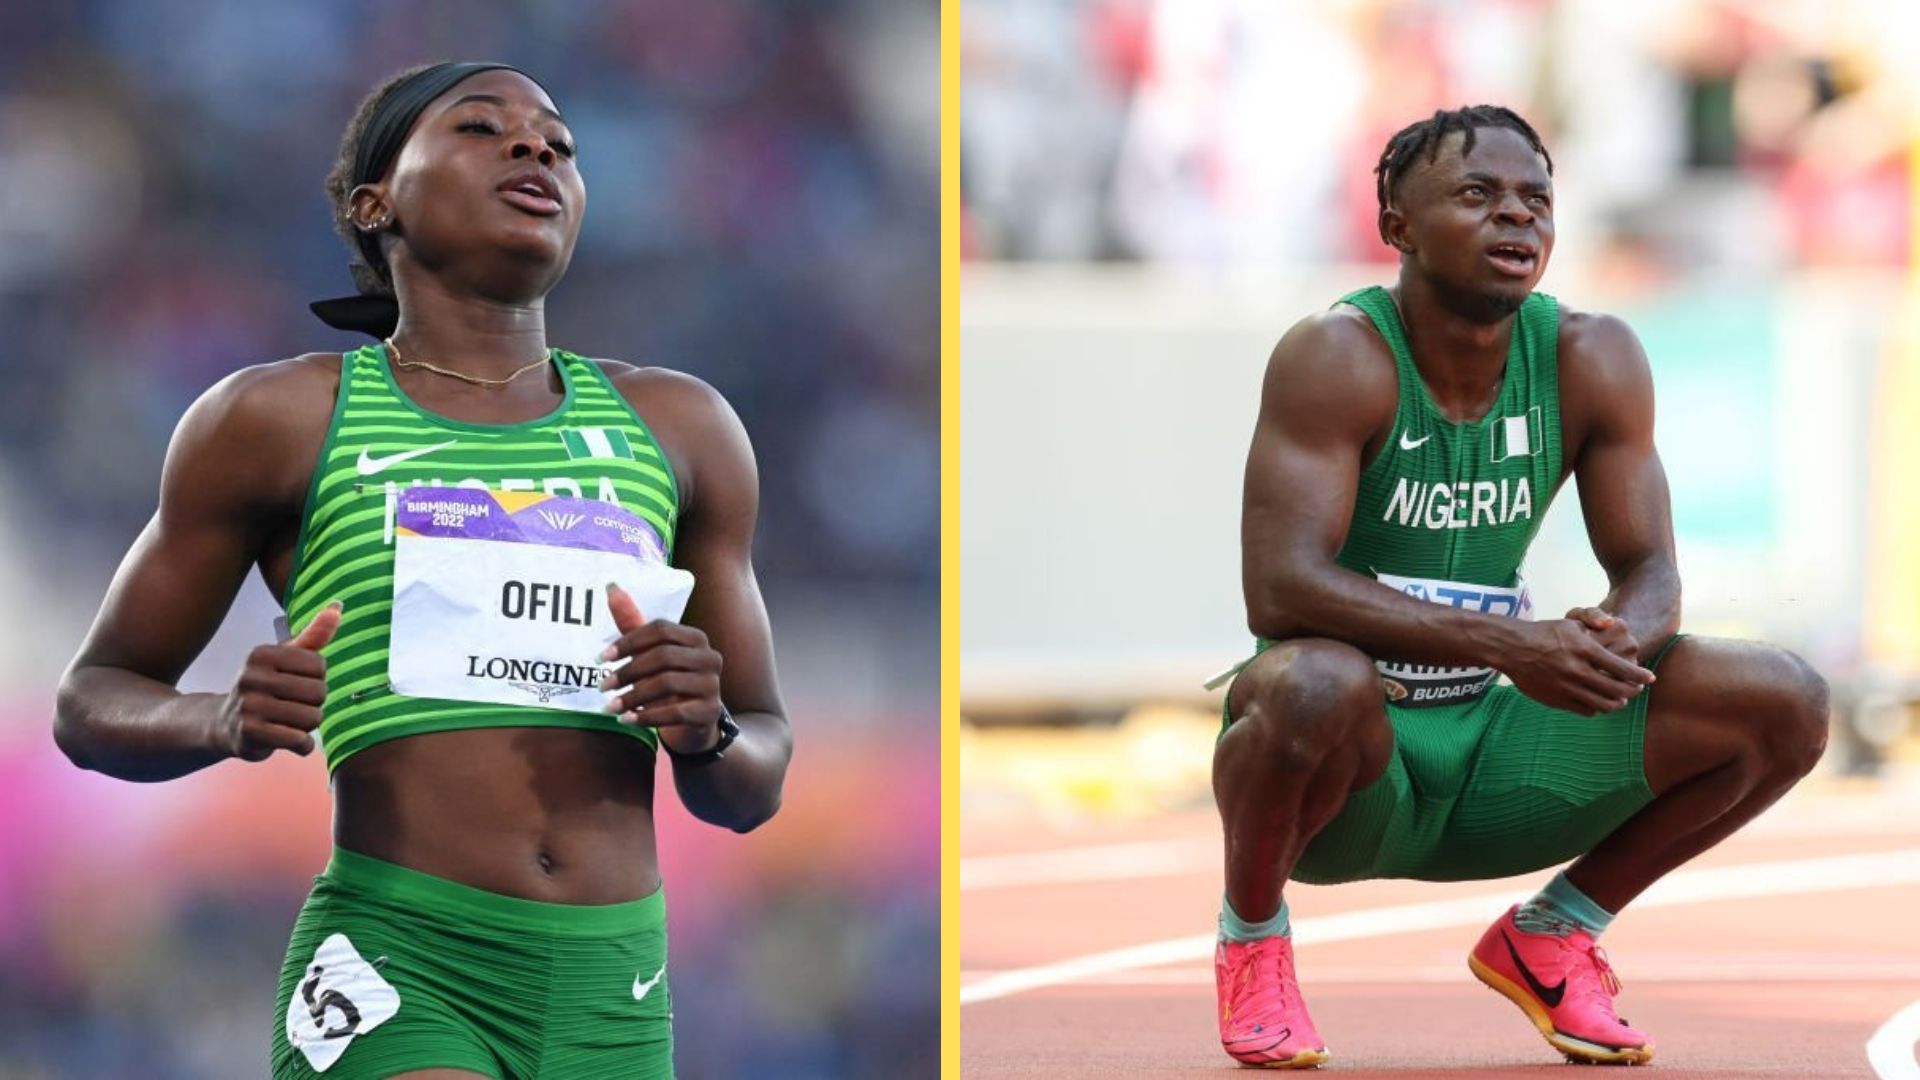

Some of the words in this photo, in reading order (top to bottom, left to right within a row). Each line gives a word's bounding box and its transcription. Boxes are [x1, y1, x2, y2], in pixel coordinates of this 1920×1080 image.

[407, 501, 489, 517] BIRMINGHAM
[1383, 477, 1532, 529] NIGERIA
[432, 513, 465, 527] 2022
[502, 580, 594, 626] OFILI
[1413, 683, 1486, 701] BUDAPE
[301, 966, 362, 1039] 5
